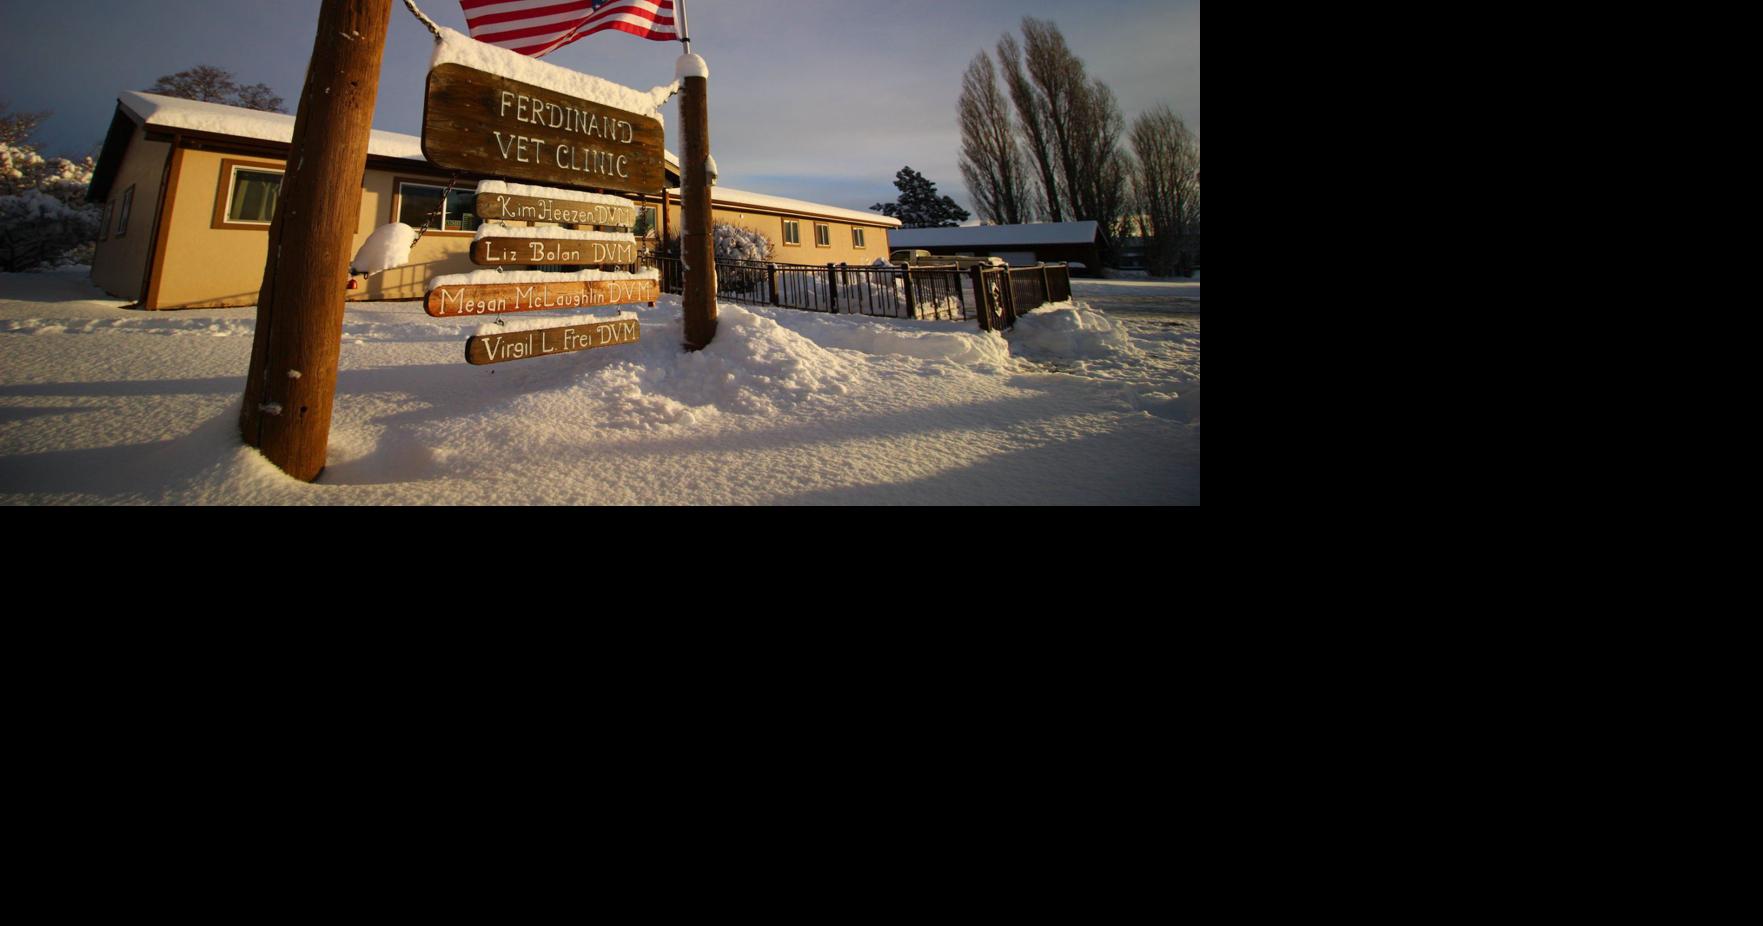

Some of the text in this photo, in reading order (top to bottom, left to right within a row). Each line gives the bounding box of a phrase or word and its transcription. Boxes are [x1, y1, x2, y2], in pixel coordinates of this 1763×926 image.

[500, 91, 633, 144] FERDINAND
[493, 131, 629, 178] VET CLINIC
[497, 195, 536, 218] Kim
[538, 200, 595, 222] Heezen
[485, 241, 632, 263] Liz Bolan DVM
[439, 287, 506, 315] Megan
[514, 286, 605, 309] McLaughlin
[481, 334, 533, 361] Virgil
[542, 332, 558, 354] L.
[564, 328, 592, 350] Frei
